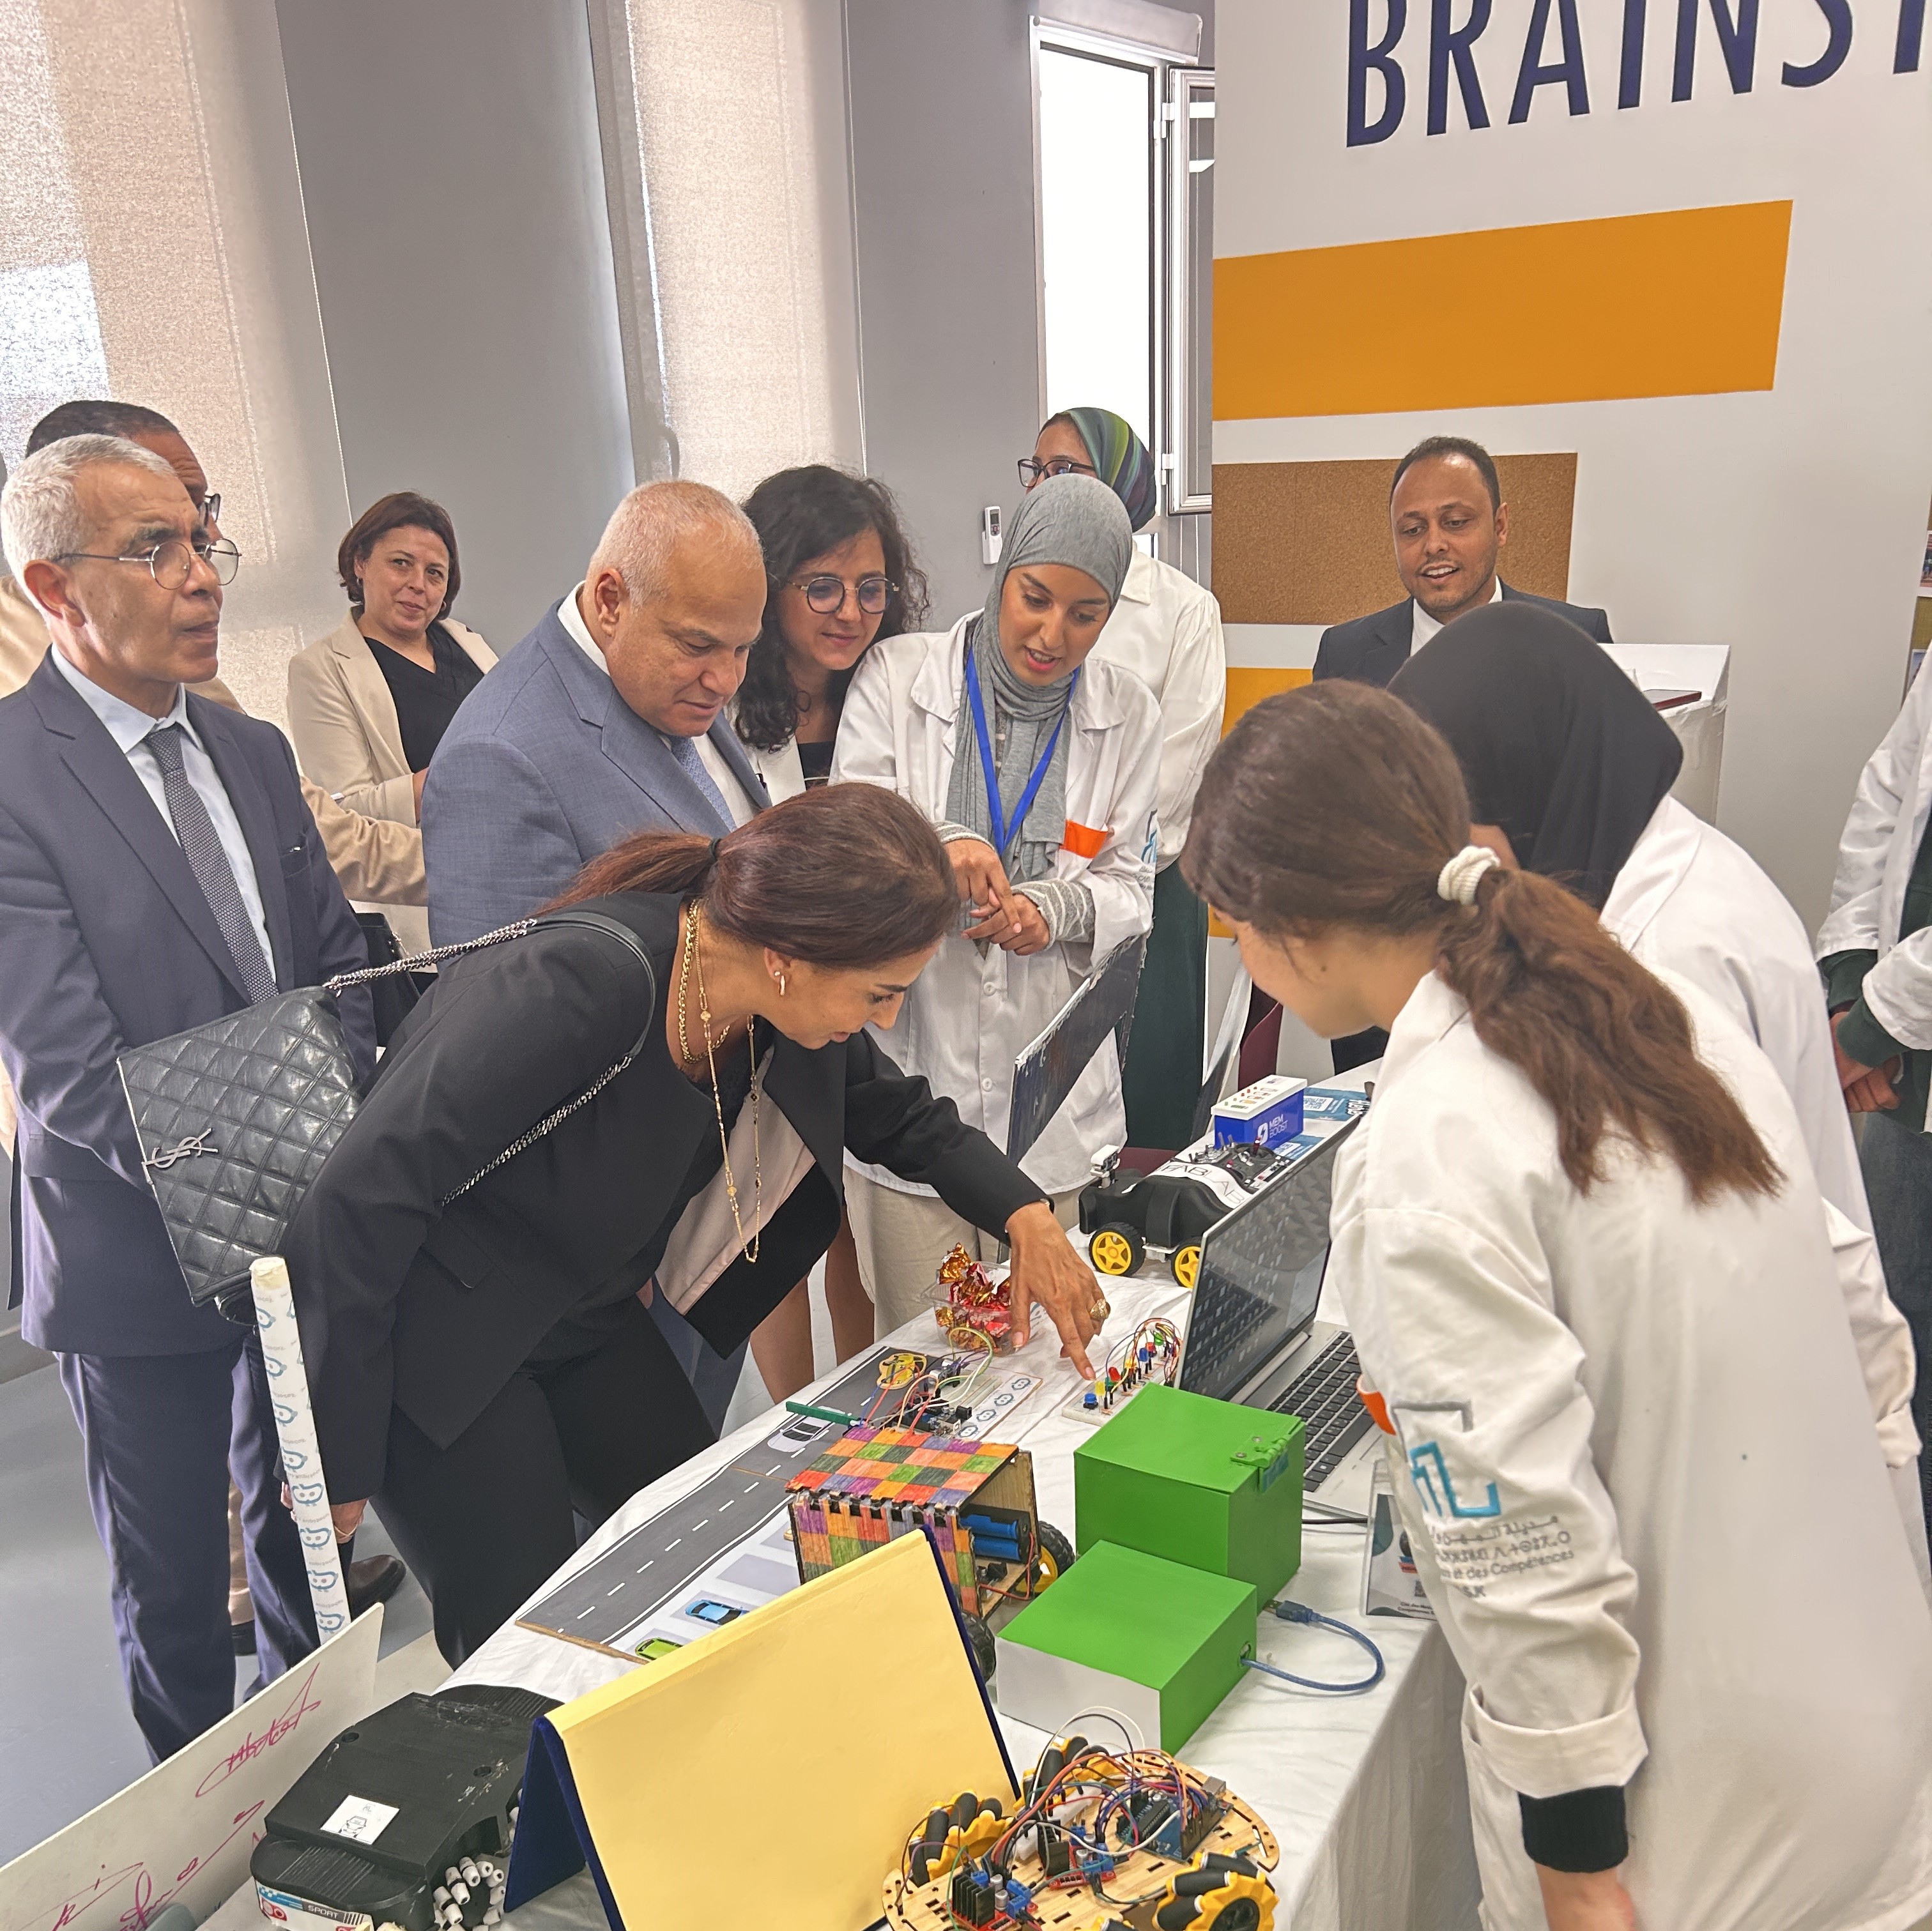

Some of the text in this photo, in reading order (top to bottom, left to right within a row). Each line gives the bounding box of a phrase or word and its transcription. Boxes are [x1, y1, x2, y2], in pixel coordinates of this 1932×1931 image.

[1269, 1114, 1284, 1129] MEM
[1269, 1120, 1289, 1139] BOOST
[1466, 1566, 1489, 1579] des
[307, 1905, 339, 1919] SPORT
